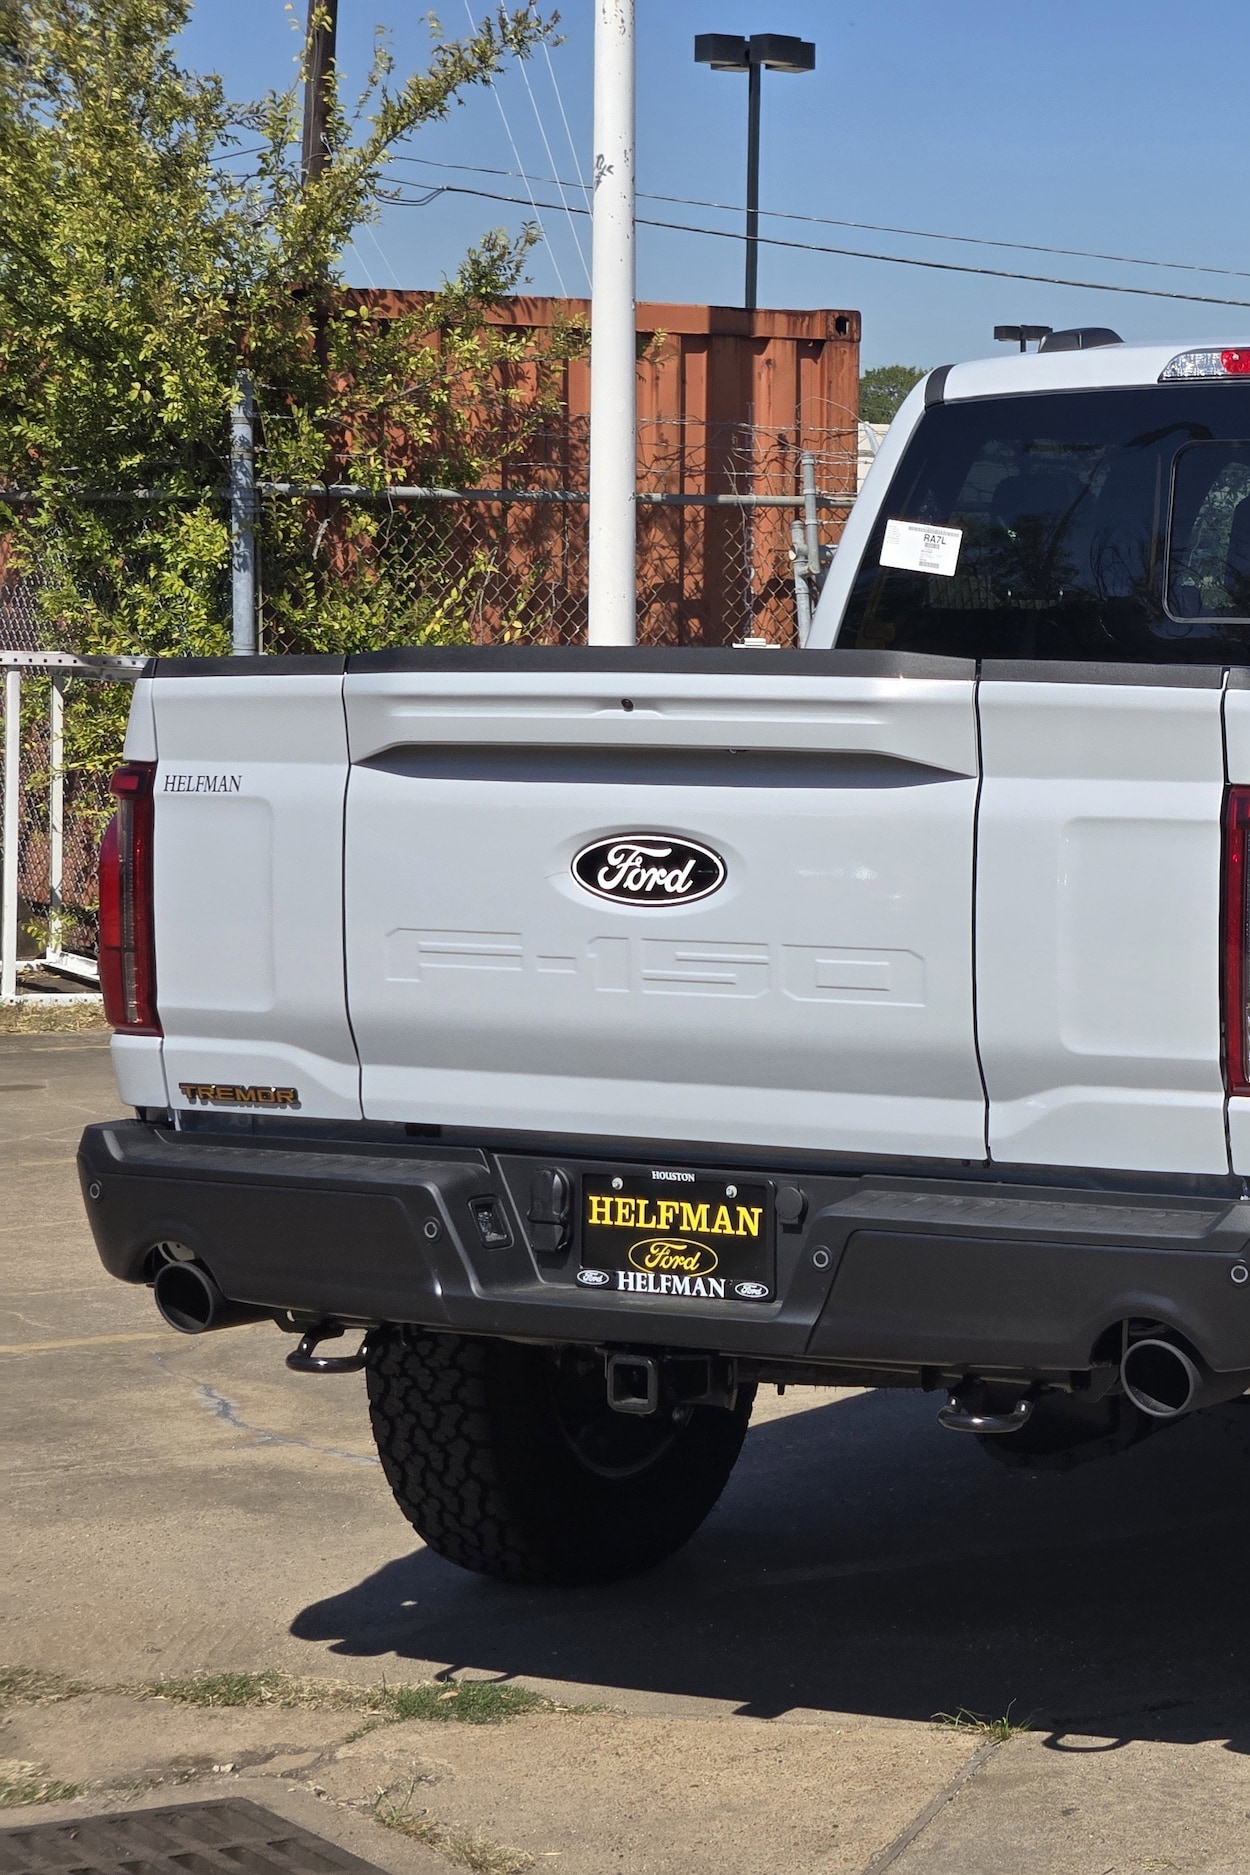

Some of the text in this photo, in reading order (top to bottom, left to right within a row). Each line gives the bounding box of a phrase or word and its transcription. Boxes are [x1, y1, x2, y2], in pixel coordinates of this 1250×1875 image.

[923, 533, 947, 545] RA7L
[163, 775, 243, 793] HELFMAN
[597, 844, 697, 893] Ford
[384, 927, 927, 1008] F-150
[179, 1083, 299, 1105] TREMOR
[651, 1170, 696, 1183] HOUSTON
[588, 1195, 764, 1237] HELFMAN
[644, 1242, 701, 1271] Ford
[616, 1271, 726, 1298] HELFMAN
